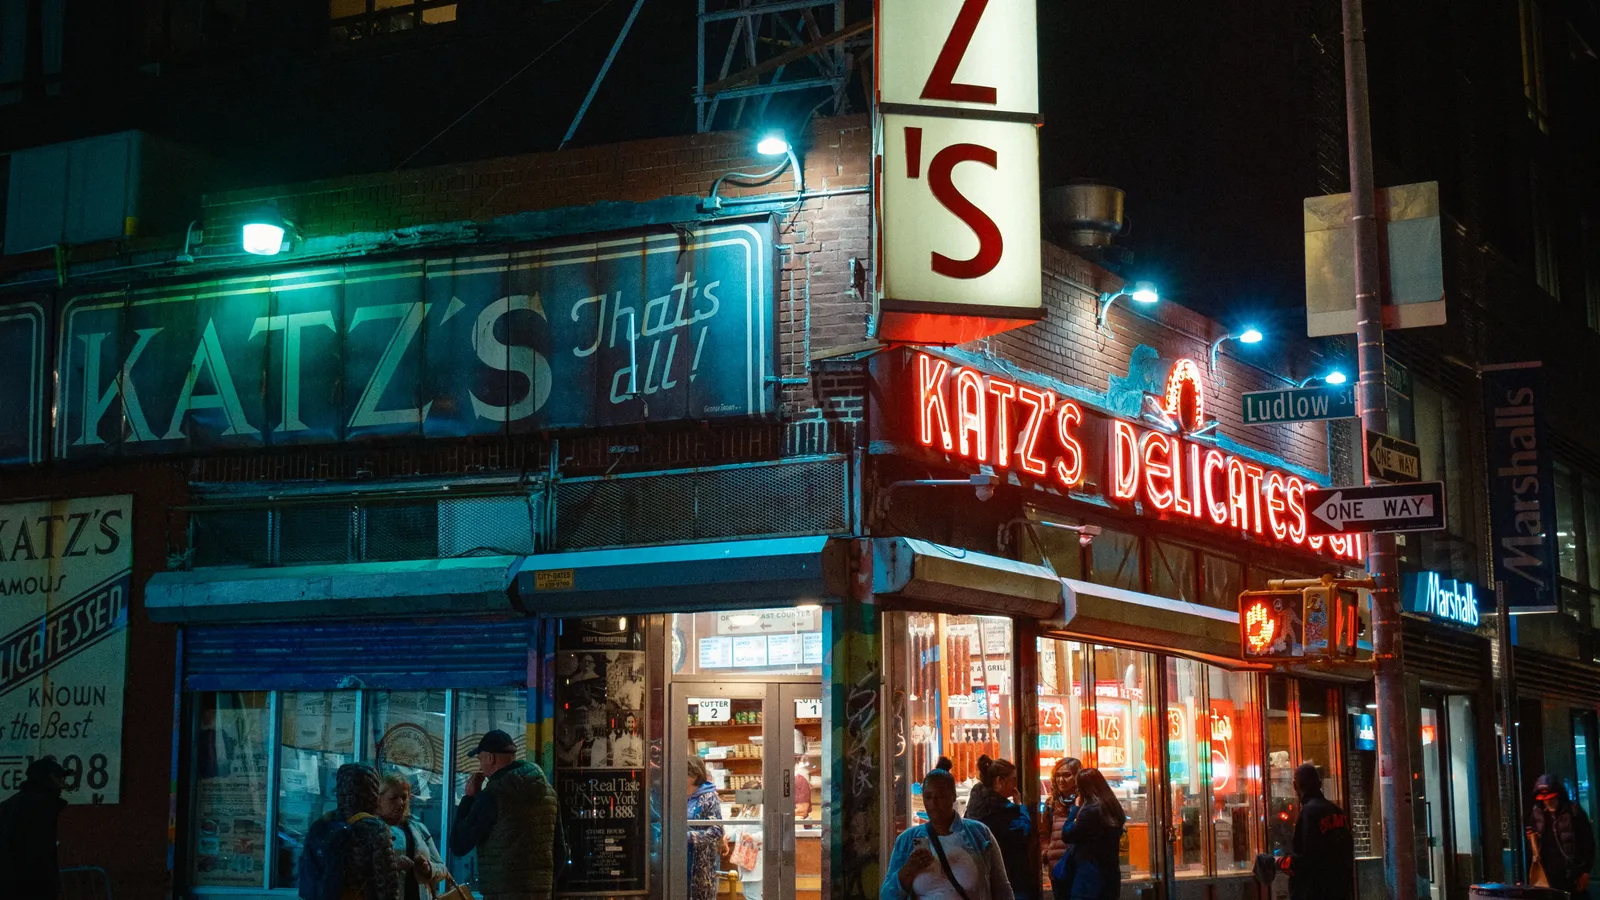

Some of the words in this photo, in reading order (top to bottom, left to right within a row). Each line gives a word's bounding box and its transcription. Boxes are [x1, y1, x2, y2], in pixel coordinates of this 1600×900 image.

[72, 290, 552, 446] KATZ'S
[1247, 392, 1329, 422] Ludlow
[1339, 389, 1353, 405] St
[920, 354, 1083, 485] KATZ'S
[1376, 448, 1392, 467] ONE
[1399, 453, 1415, 474] WAY
[1113, 419, 1363, 561] DELICATES
[1494, 386, 1546, 588] Marshalls
[1326, 501, 1364, 520] ONE
[1383, 497, 1425, 517] WAY
[1425, 570, 1479, 627] Marshalls
[28, 685, 106, 708] KNOWN
[700, 700, 729, 708] CUTTER
[711, 708, 718, 719] 2
[810, 704, 817, 715] 1
[10, 712, 40, 740] the
[40, 711, 94, 740] Best
[561, 779, 586, 793] The
[589, 777, 617, 792] Real
[617, 777, 641, 792] Taste
[565, 791, 580, 806] of
[582, 792, 611, 805] New
[570, 804, 606, 819] Since
